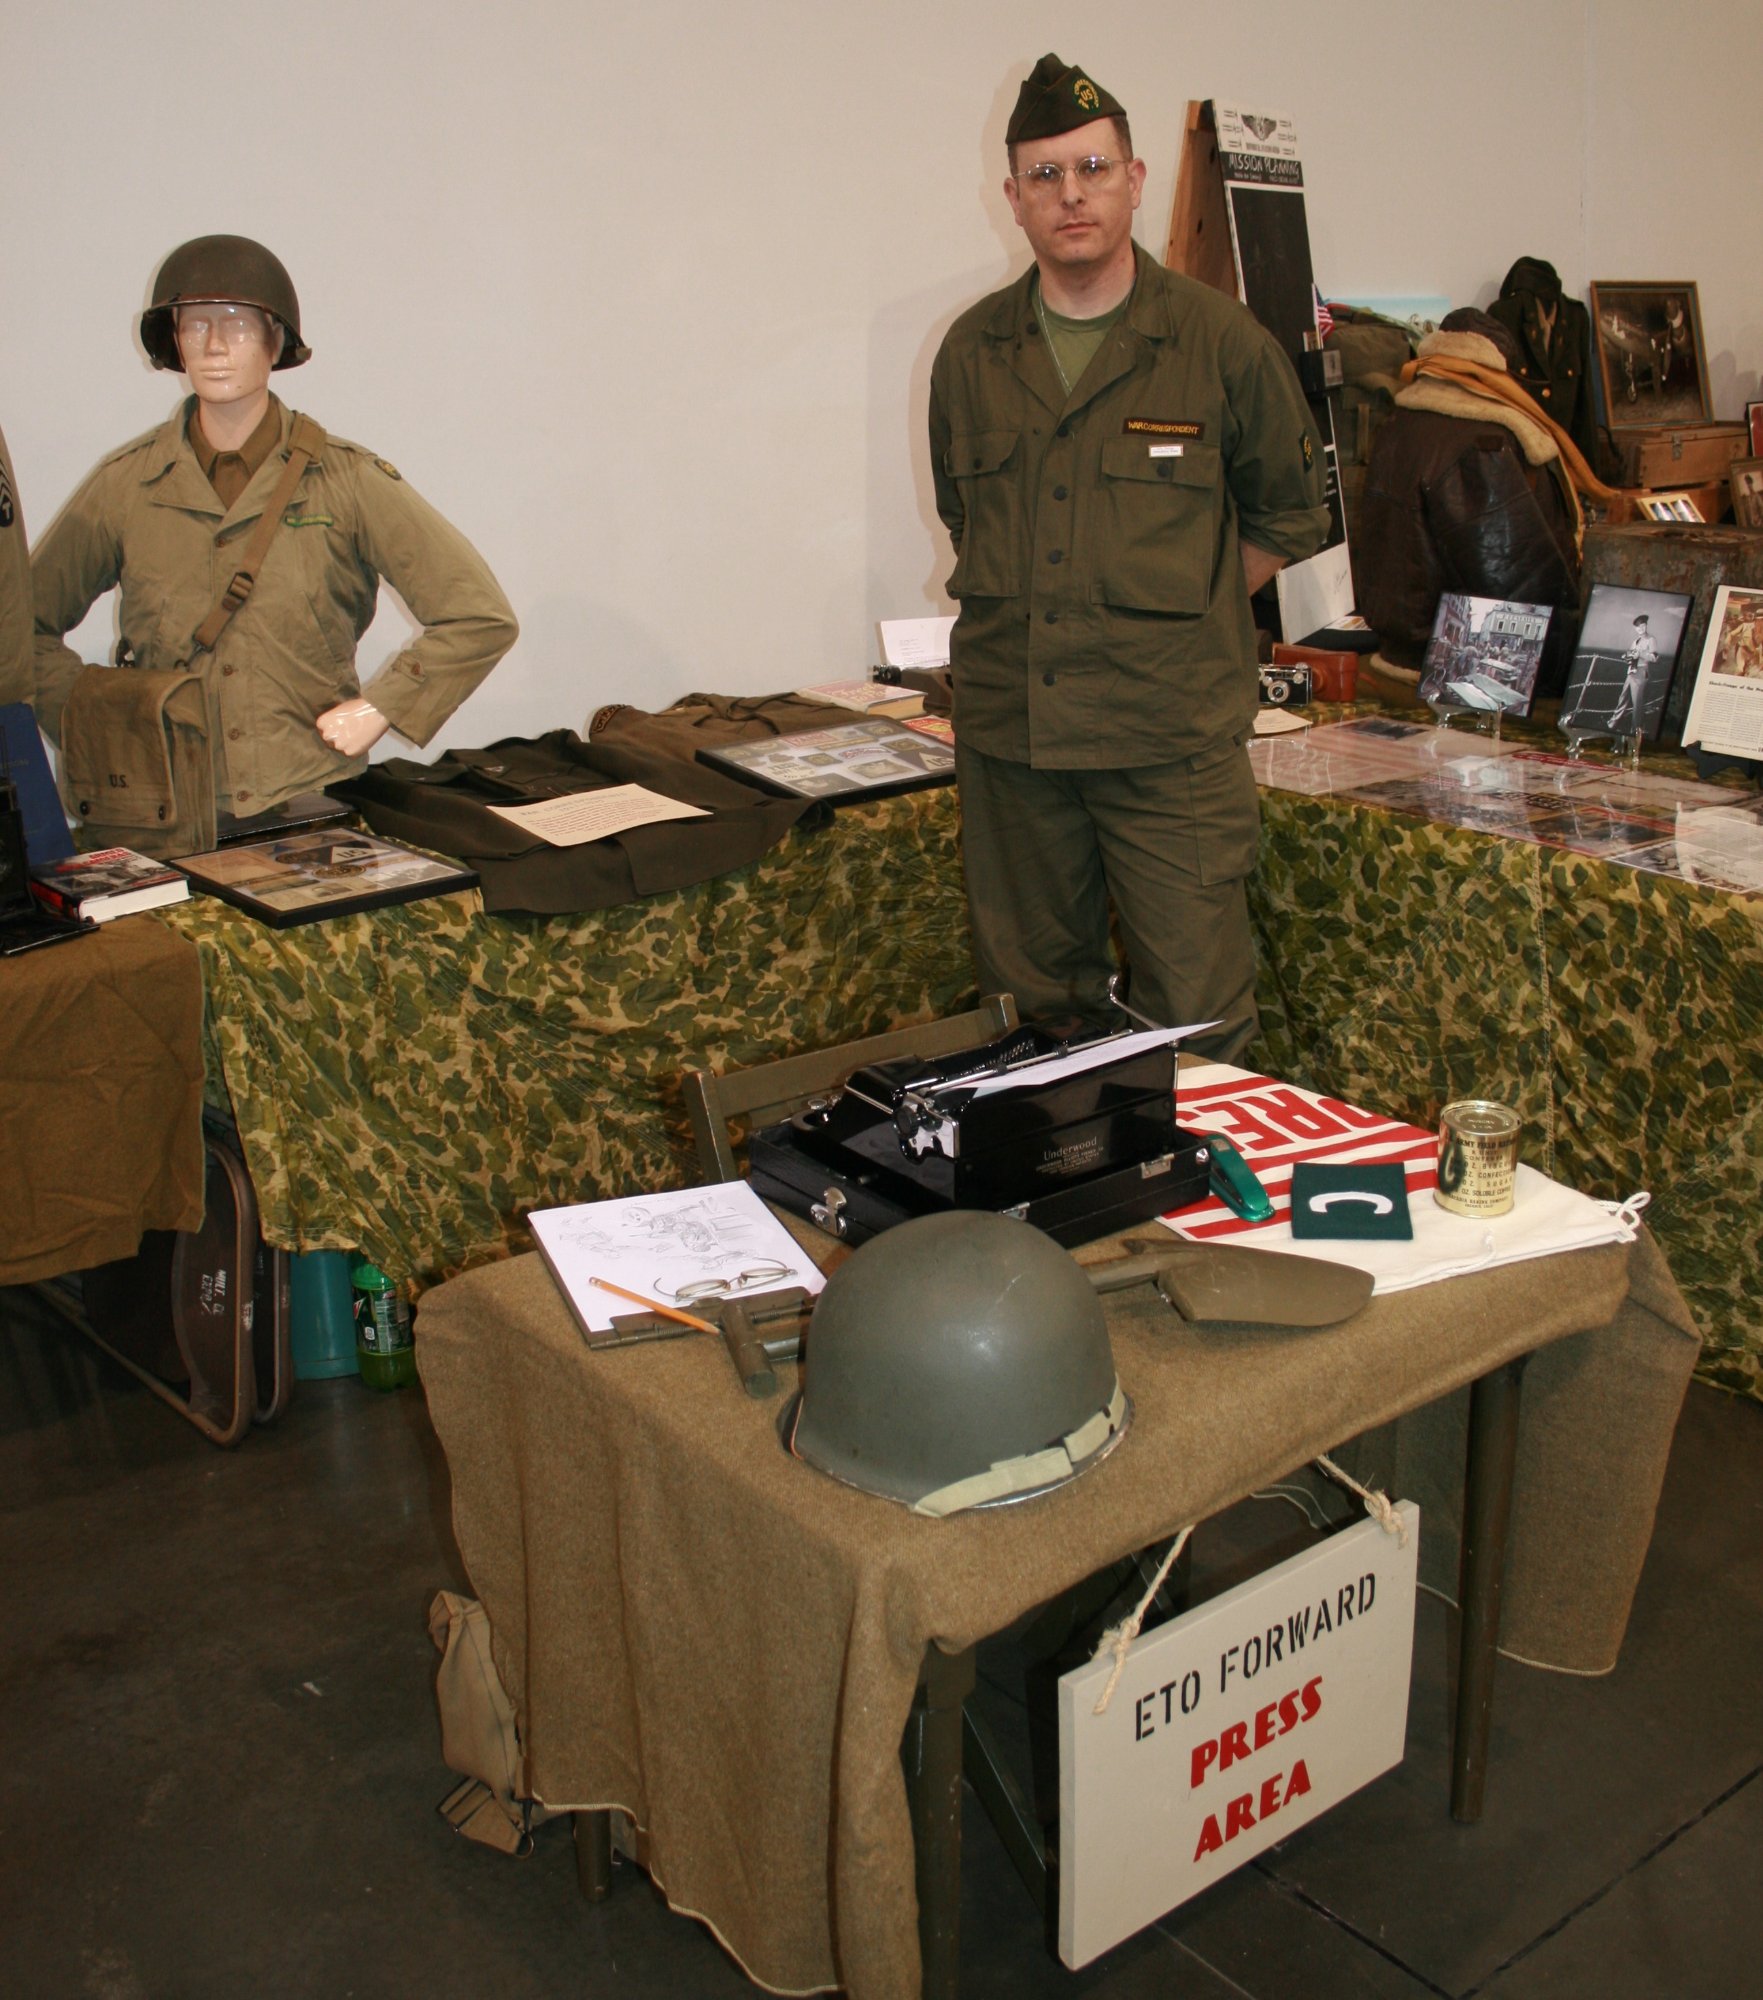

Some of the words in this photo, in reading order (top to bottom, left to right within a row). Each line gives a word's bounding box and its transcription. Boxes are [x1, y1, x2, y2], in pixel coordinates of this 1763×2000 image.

[1229, 153, 1263, 172] MISSION
[1264, 157, 1300, 179] PLANNING
[1128, 421, 1143, 430] WAR
[109, 774, 129, 788] U.S.
[1043, 1136, 1098, 1161] Underwood
[1135, 1669, 1201, 1742] ETO
[1220, 1571, 1377, 1694] FORWARD
[1190, 1675, 1323, 1789] PRESS
[1193, 1758, 1312, 1863] AREA
